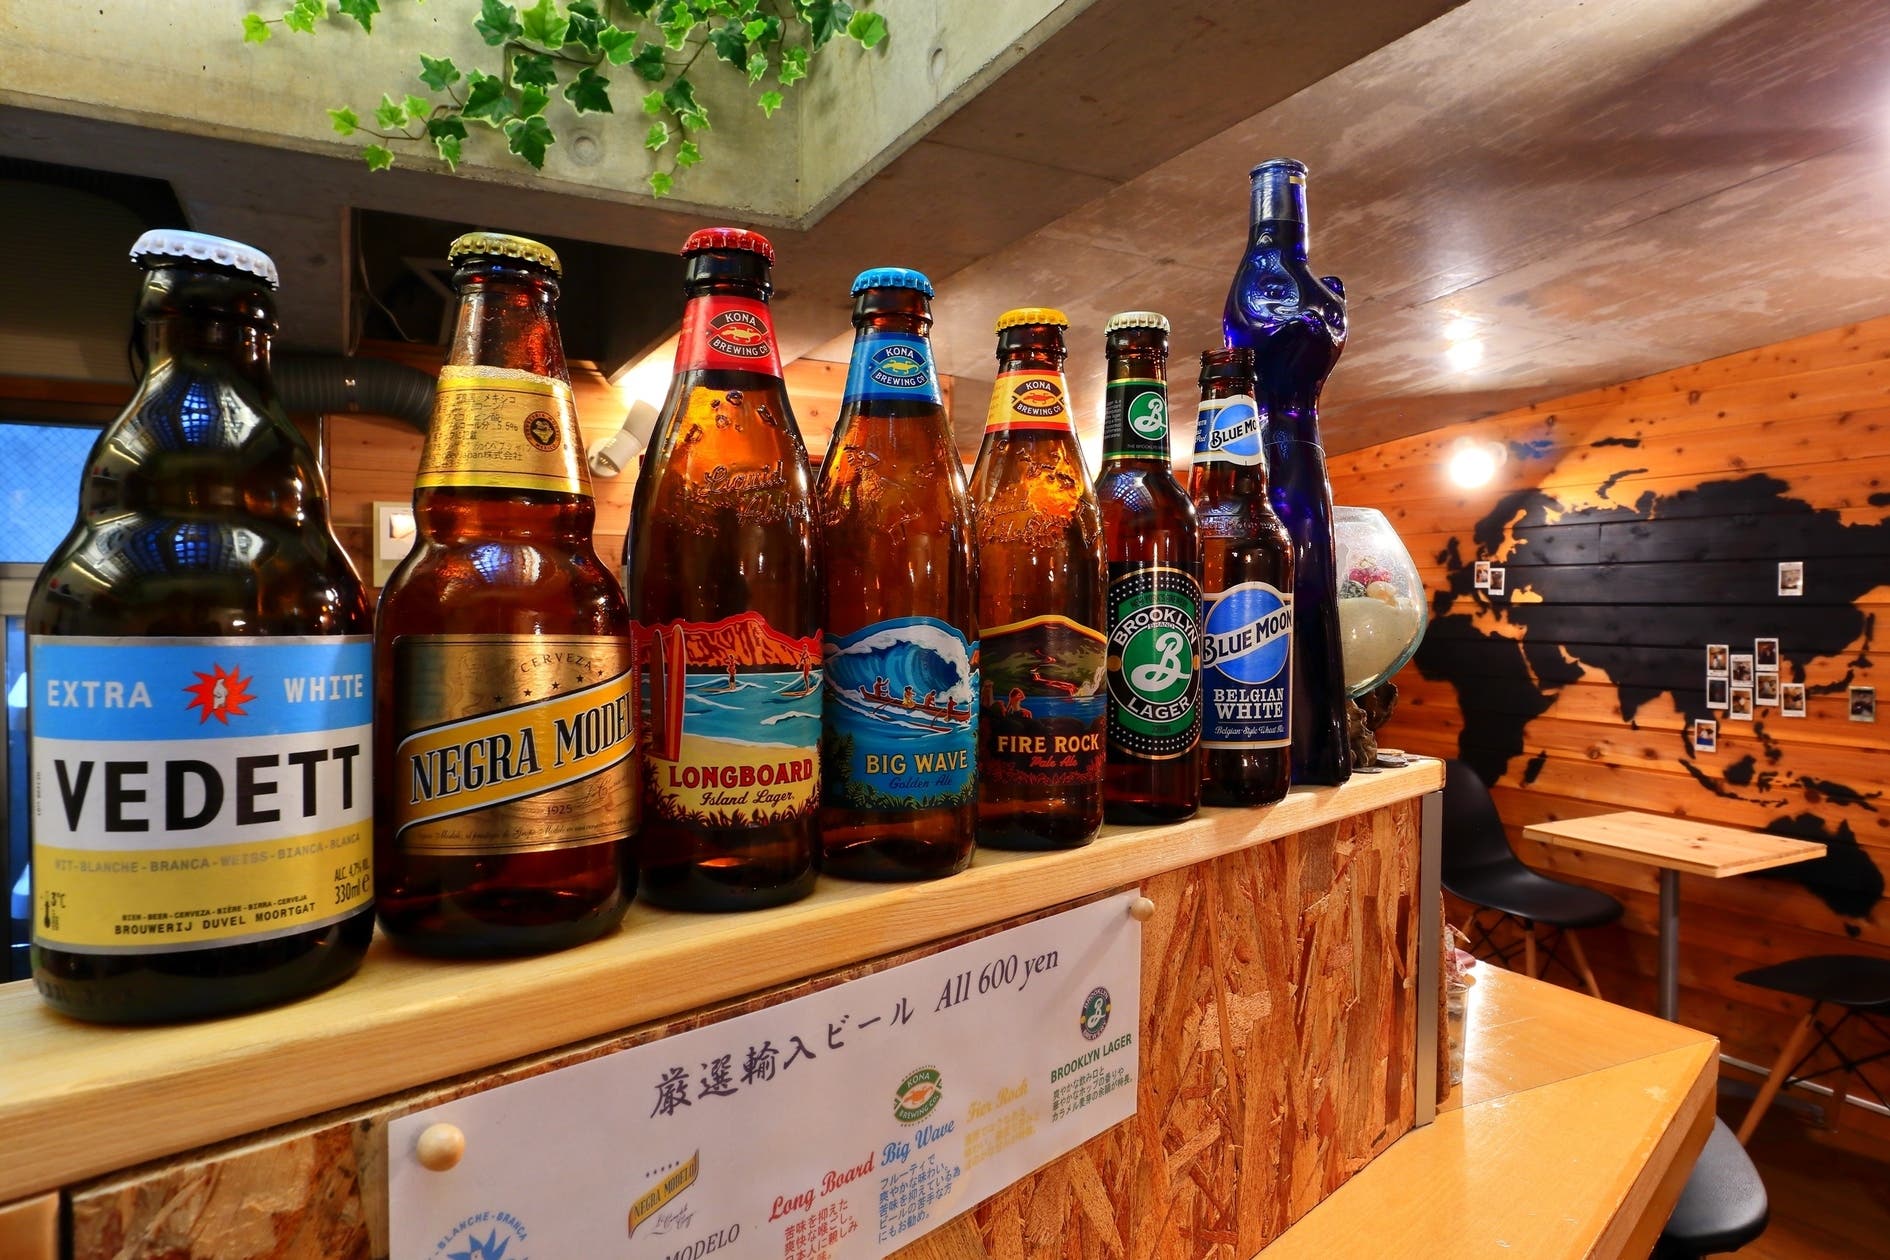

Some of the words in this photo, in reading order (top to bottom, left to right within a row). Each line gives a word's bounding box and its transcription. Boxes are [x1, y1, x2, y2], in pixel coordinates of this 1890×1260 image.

[725, 313, 757, 326] KONA
[713, 339, 758, 356] BREWING
[885, 347, 914, 358] KONA
[875, 372, 916, 386] BREWING
[1025, 381, 1051, 391] KONA
[1016, 403, 1053, 415] BREWING
[1210, 424, 1243, 448] BLUE
[1113, 609, 1197, 648] BROOKLYN
[1203, 632, 1252, 665] BLUE
[1256, 610, 1292, 644] MOON
[520, 653, 592, 673] CERVEZA
[47, 680, 152, 708] EXTRA
[283, 673, 364, 703] WHITE
[1213, 688, 1284, 702] BELGIAN
[1127, 695, 1190, 719] LAGER
[1214, 702, 1283, 719] WHITE
[997, 735, 1047, 754] FIRE
[1054, 733, 1100, 753] ROCK
[410, 727, 542, 804] NEGRA
[669, 758, 813, 789] LONGBOARD
[866, 754, 907, 775] BIG
[914, 750, 968, 774] WAVE
[54, 744, 360, 832] VEDETT
[889, 776, 930, 789] Golden
[547, 804, 573, 815] 1925
[700, 791, 749, 806] Island
[753, 789, 793, 807] Lager
[335, 882, 360, 904] 330ml
[115, 921, 193, 935] BROUWERIJ
[202, 915, 247, 929] DUVEL
[255, 903, 316, 922] MOORTGAT
[650, 997, 915, 1118] 厳選輸入ビール
[935, 971, 972, 1012] All
[978, 954, 1018, 994] 600
[1018, 951, 1058, 991] yen
[1051, 1048, 1100, 1083] BROOKLYN
[1103, 1033, 1132, 1062] LAGER
[907, 1072, 930, 1088] KONA
[881, 1142, 911, 1167] Big
[915, 1120, 955, 1150] Wave
[880, 1153, 936, 1190] フルーティで
[634, 1189, 661, 1220] NEGRA
[664, 1162, 695, 1197] MODELO
[769, 1189, 815, 1222] Long
[820, 1152, 875, 1196] Board
[880, 1183, 952, 1230] ビールの苦手な方
[785, 1199, 848, 1241] 苦味を抑えた
